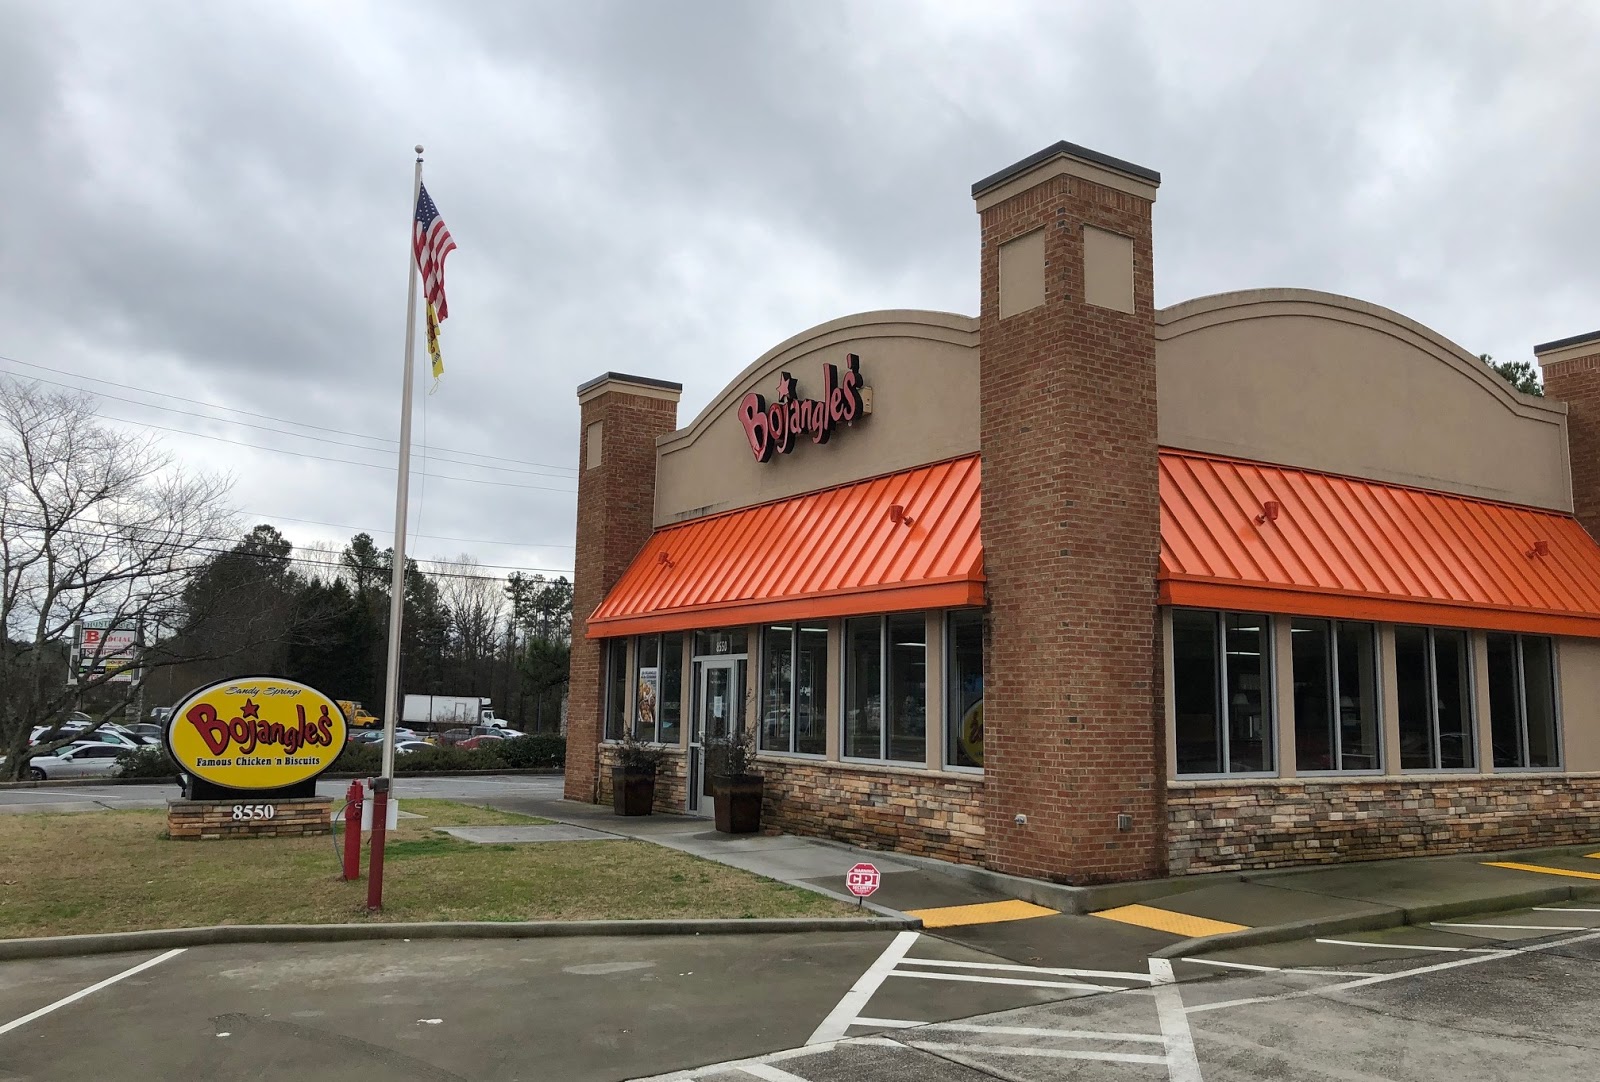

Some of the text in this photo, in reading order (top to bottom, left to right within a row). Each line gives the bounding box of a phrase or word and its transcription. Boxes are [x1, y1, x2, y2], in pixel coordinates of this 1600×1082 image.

[715, 641, 728, 652] 8550
[224, 686, 302, 698] Sandy Springs
[196, 757, 232, 767] Famous
[235, 756, 272, 766] Chicken
[284, 756, 320, 766] Biscuits
[232, 804, 275, 820] 8550
[849, 873, 878, 886] CPI
